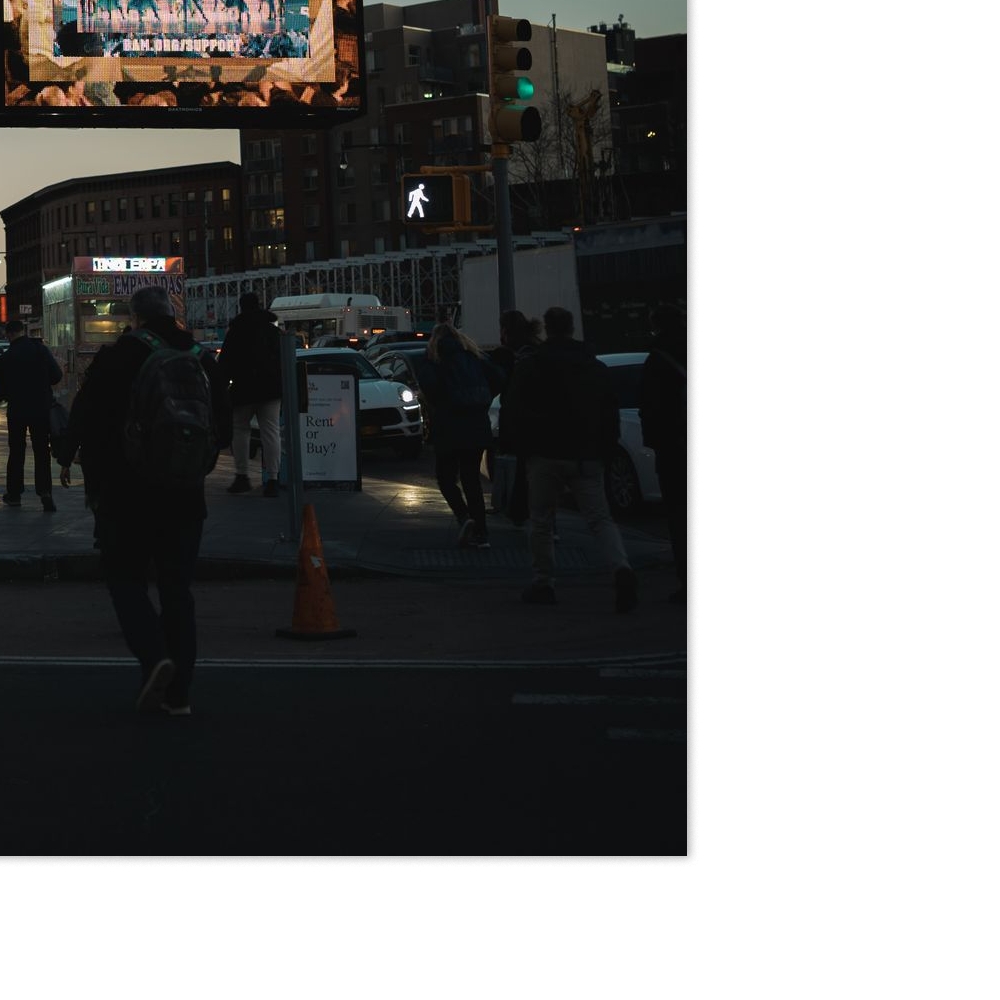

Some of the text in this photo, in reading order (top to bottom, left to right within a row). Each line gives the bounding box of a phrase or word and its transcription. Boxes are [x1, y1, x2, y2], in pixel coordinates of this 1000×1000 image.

[123, 39, 241, 52] BAM.ORG/SUPPORT
[114, 275, 183, 295] EMPANADAS
[306, 416, 334, 427] Rent
[306, 431, 319, 439] or
[307, 442, 336, 456] Buy?
